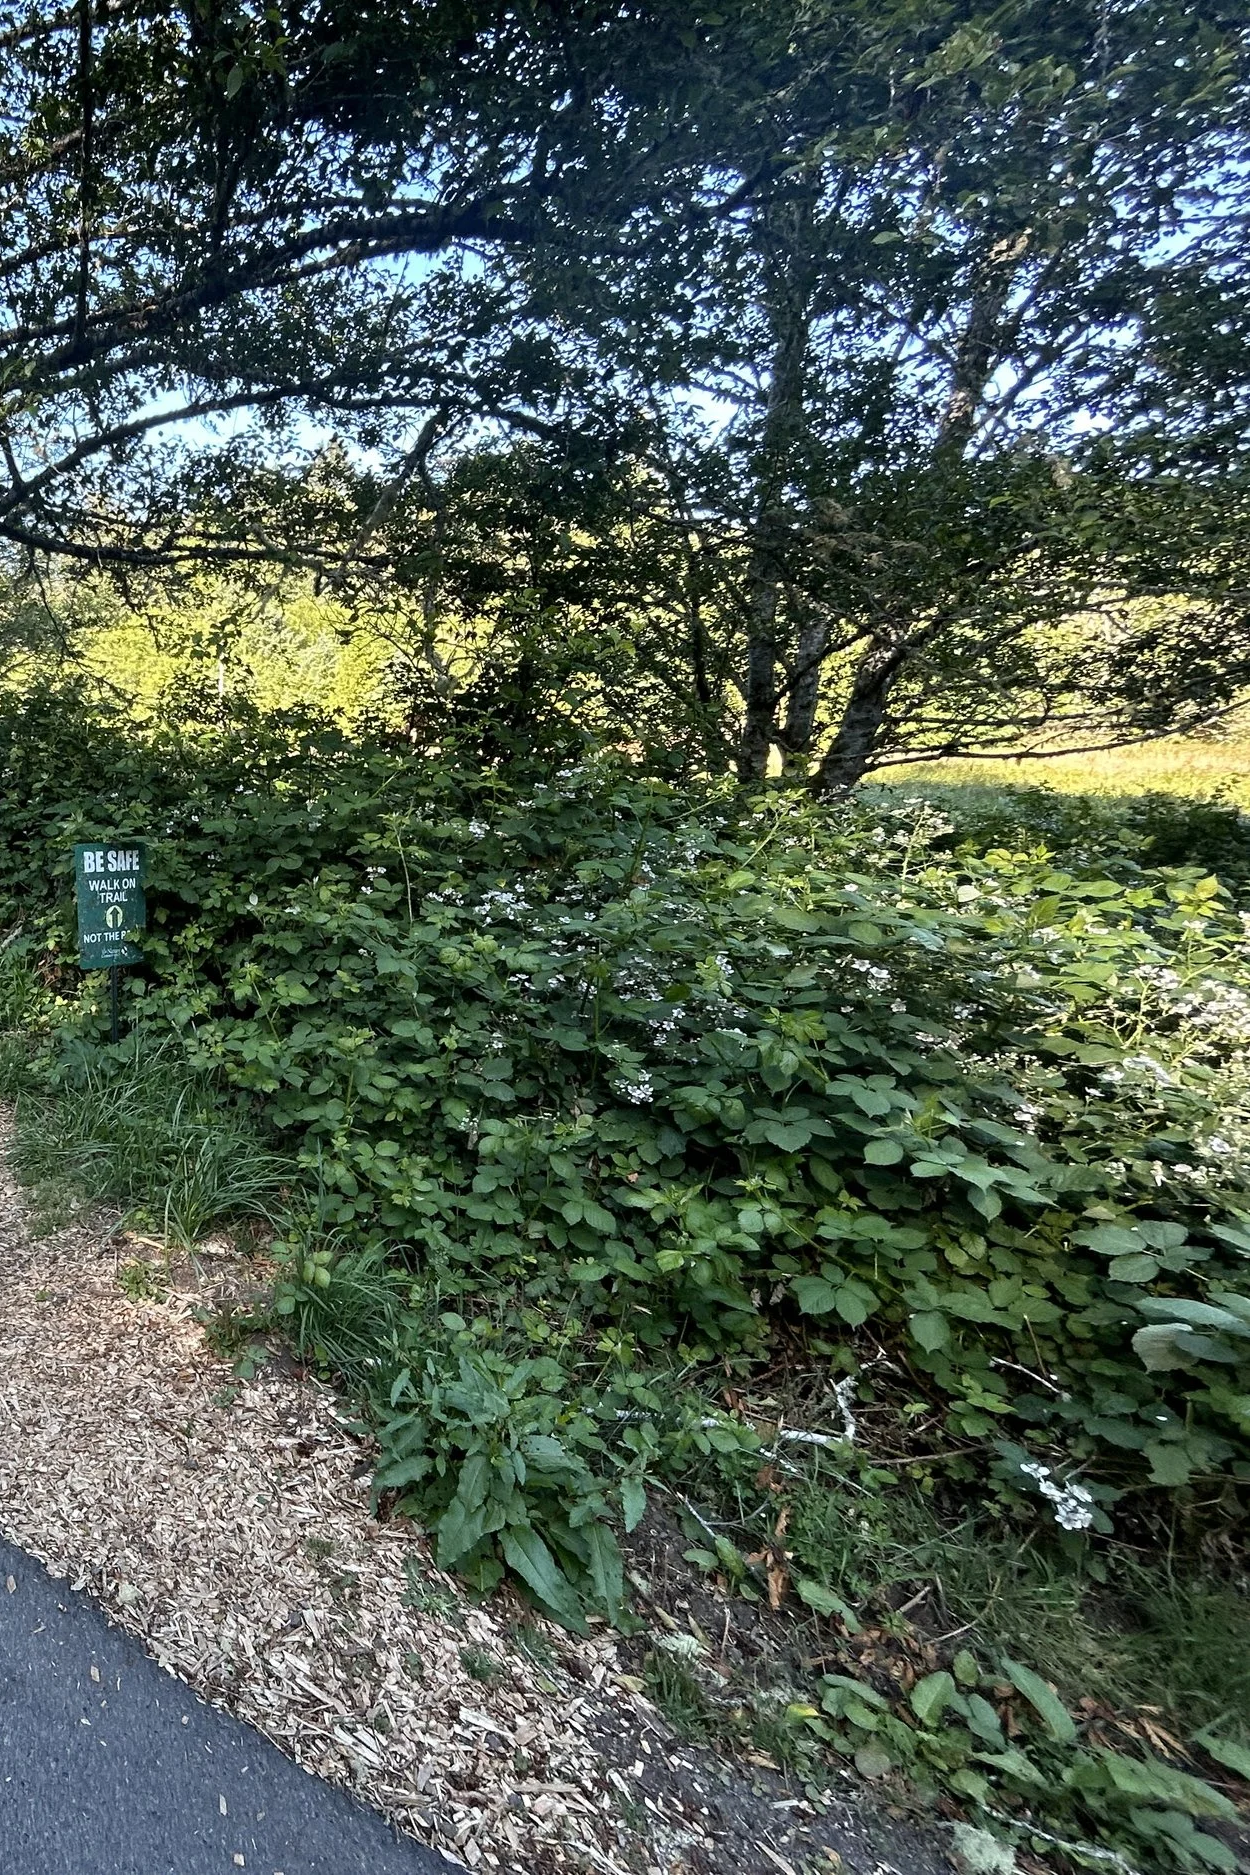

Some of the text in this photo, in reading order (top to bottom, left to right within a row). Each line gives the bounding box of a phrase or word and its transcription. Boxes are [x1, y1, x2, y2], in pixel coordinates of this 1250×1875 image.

[83, 850, 140, 873] BE SAFE
[88, 877, 136, 892] WALK ON
[99, 891, 128, 903] TRAIL
[83, 933, 102, 944] NOT
[103, 931, 120, 942] THE
